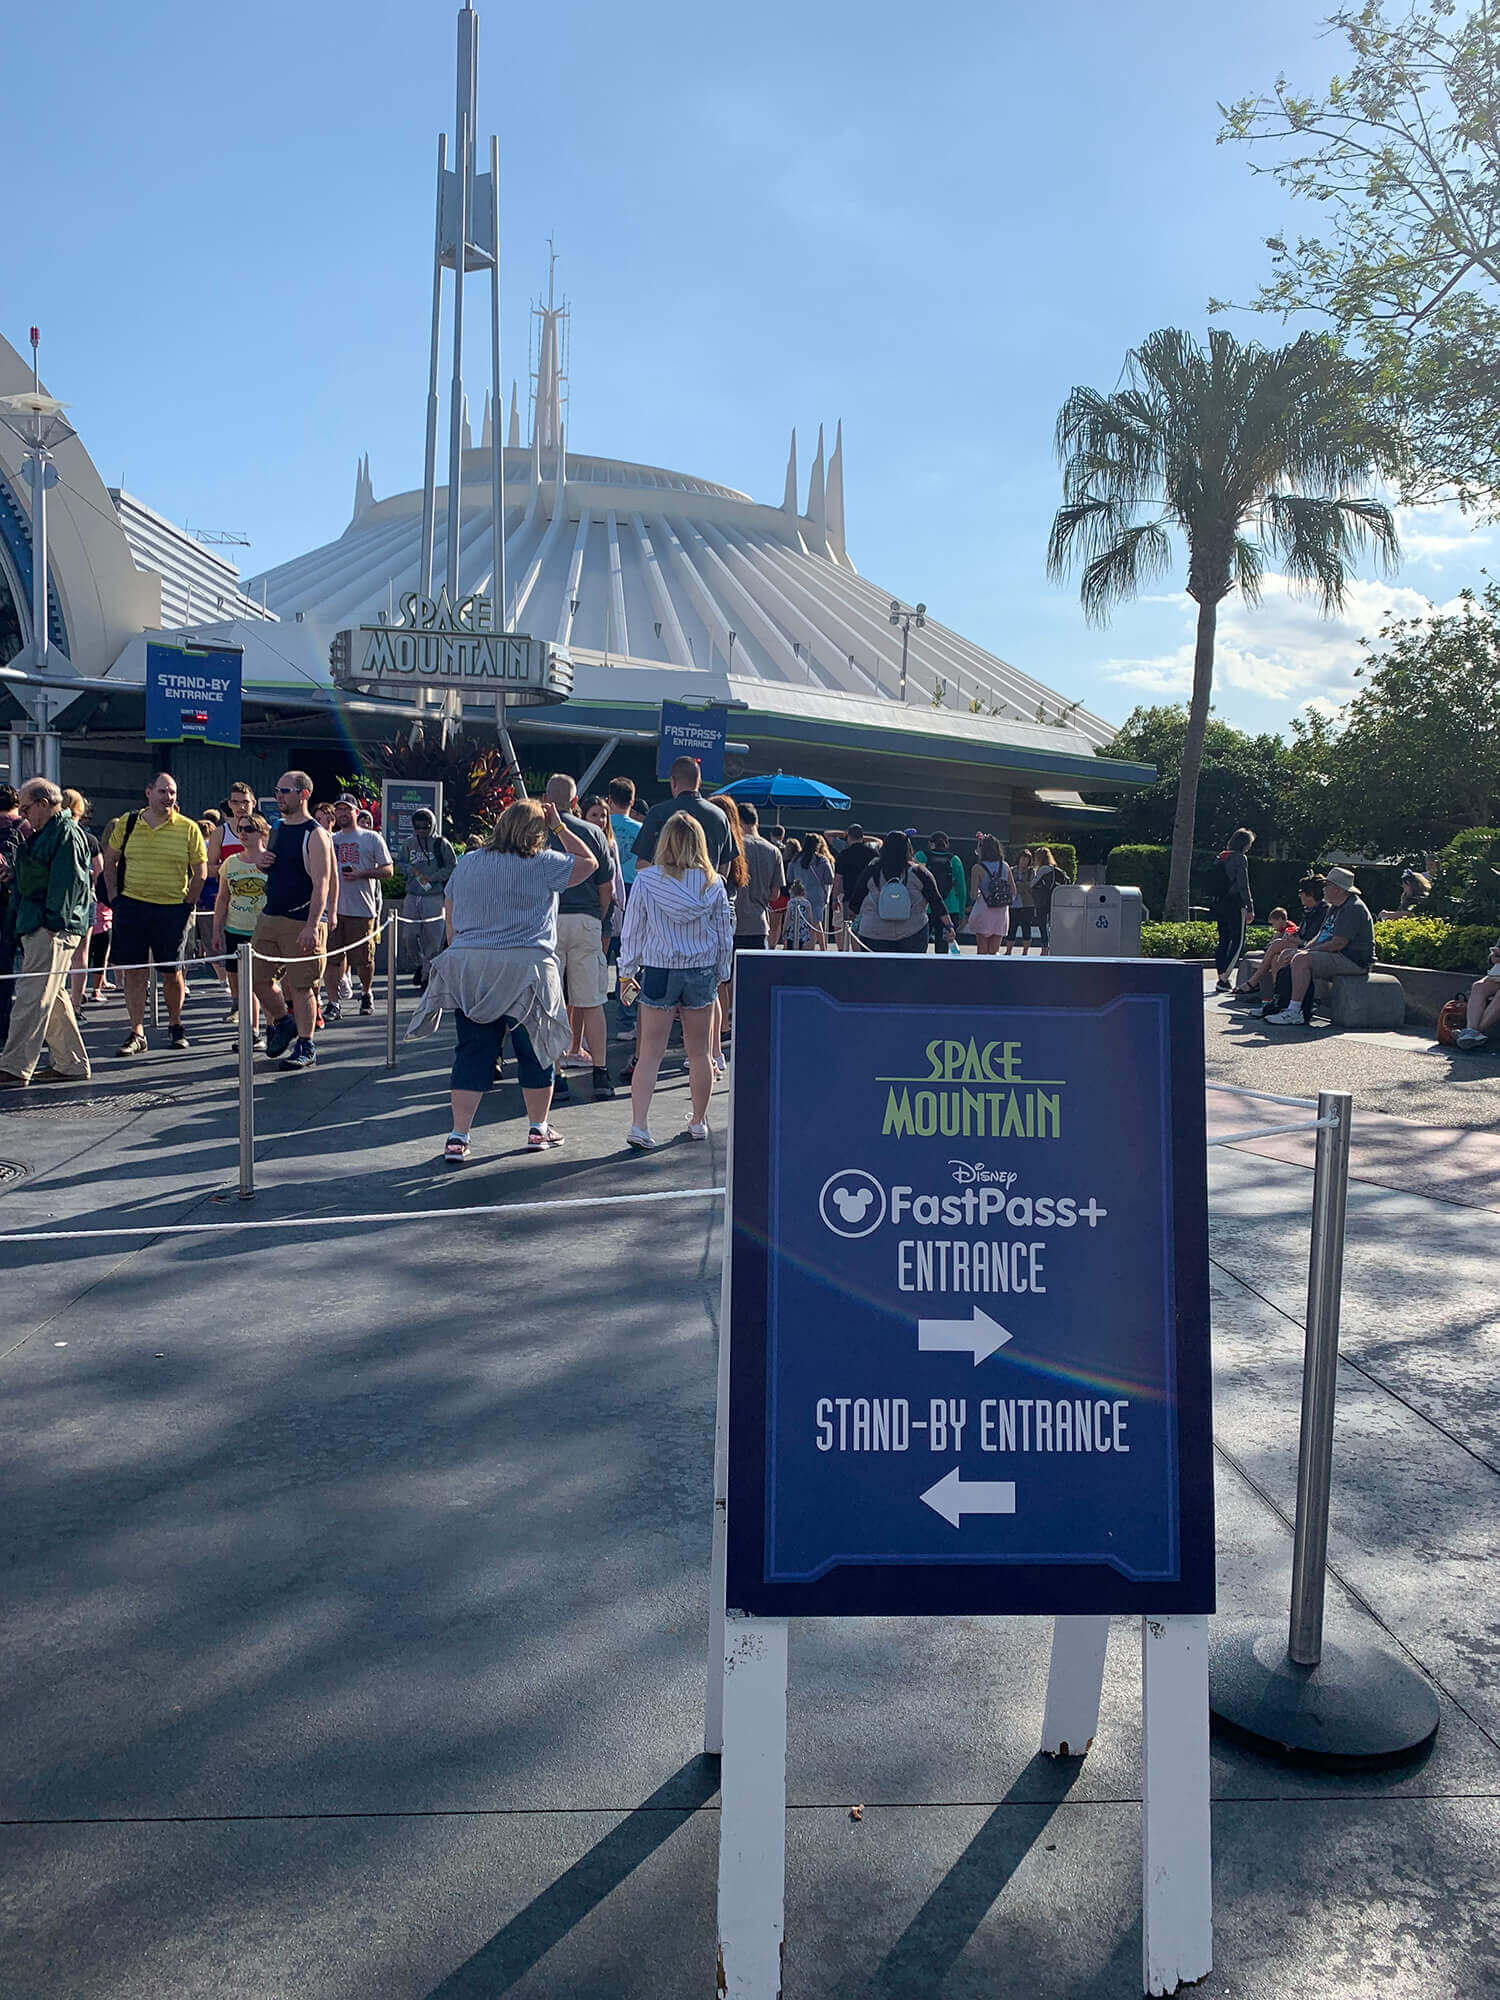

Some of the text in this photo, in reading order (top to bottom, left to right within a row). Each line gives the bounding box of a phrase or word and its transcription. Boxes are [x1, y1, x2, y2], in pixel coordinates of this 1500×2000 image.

[399, 584, 492, 632] SPACE
[361, 632, 530, 680] MOUNTAIN
[157, 673, 231, 692] STAND-BY
[165, 687, 224, 702] ENTRANCE
[664, 725, 722, 740] FASTPASS+
[672, 737, 713, 749] ENTRANCE
[926, 1035, 1022, 1081] SPACE
[882, 1085, 1061, 1140] MOUNTAIN
[891, 1186, 1108, 1228] FastPass+
[898, 1240, 1047, 1293] ENTRANCE
[816, 1398, 1130, 1452] STAND-BY ENTRANCE
